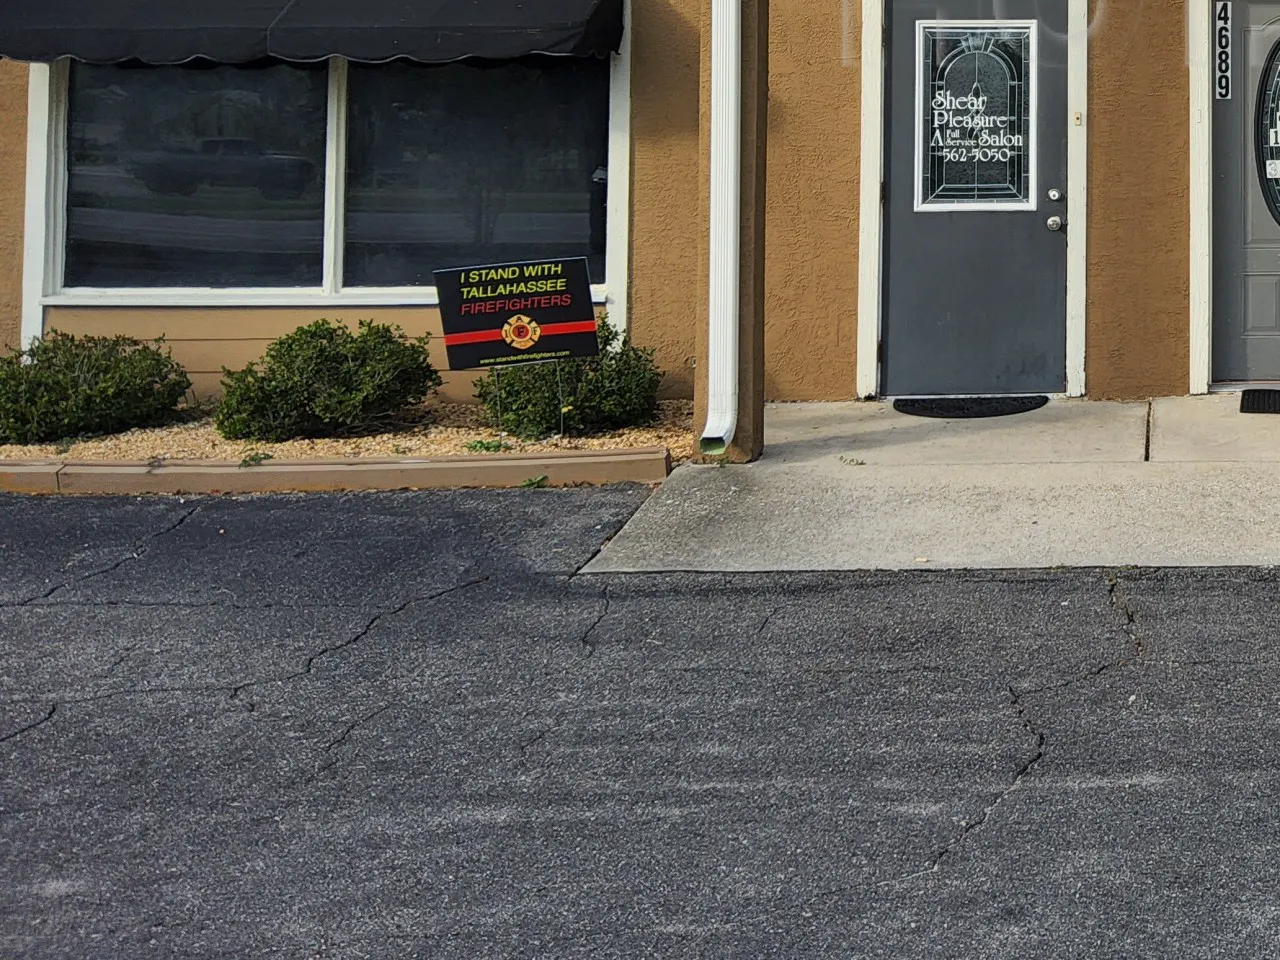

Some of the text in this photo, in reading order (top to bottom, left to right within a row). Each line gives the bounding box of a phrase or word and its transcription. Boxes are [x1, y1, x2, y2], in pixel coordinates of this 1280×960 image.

[1216, 2, 1231, 99] 4689
[932, 90, 988, 110] Shear
[932, 110, 1008, 128] Pleasure
[978, 129, 1023, 147] Salon
[942, 148, 1011, 162] 562-5050
[460, 263, 562, 284] I STAND WITH
[460, 278, 567, 299] TALLAHASSEE
[460, 294, 571, 315] FIREFIGHTERS
